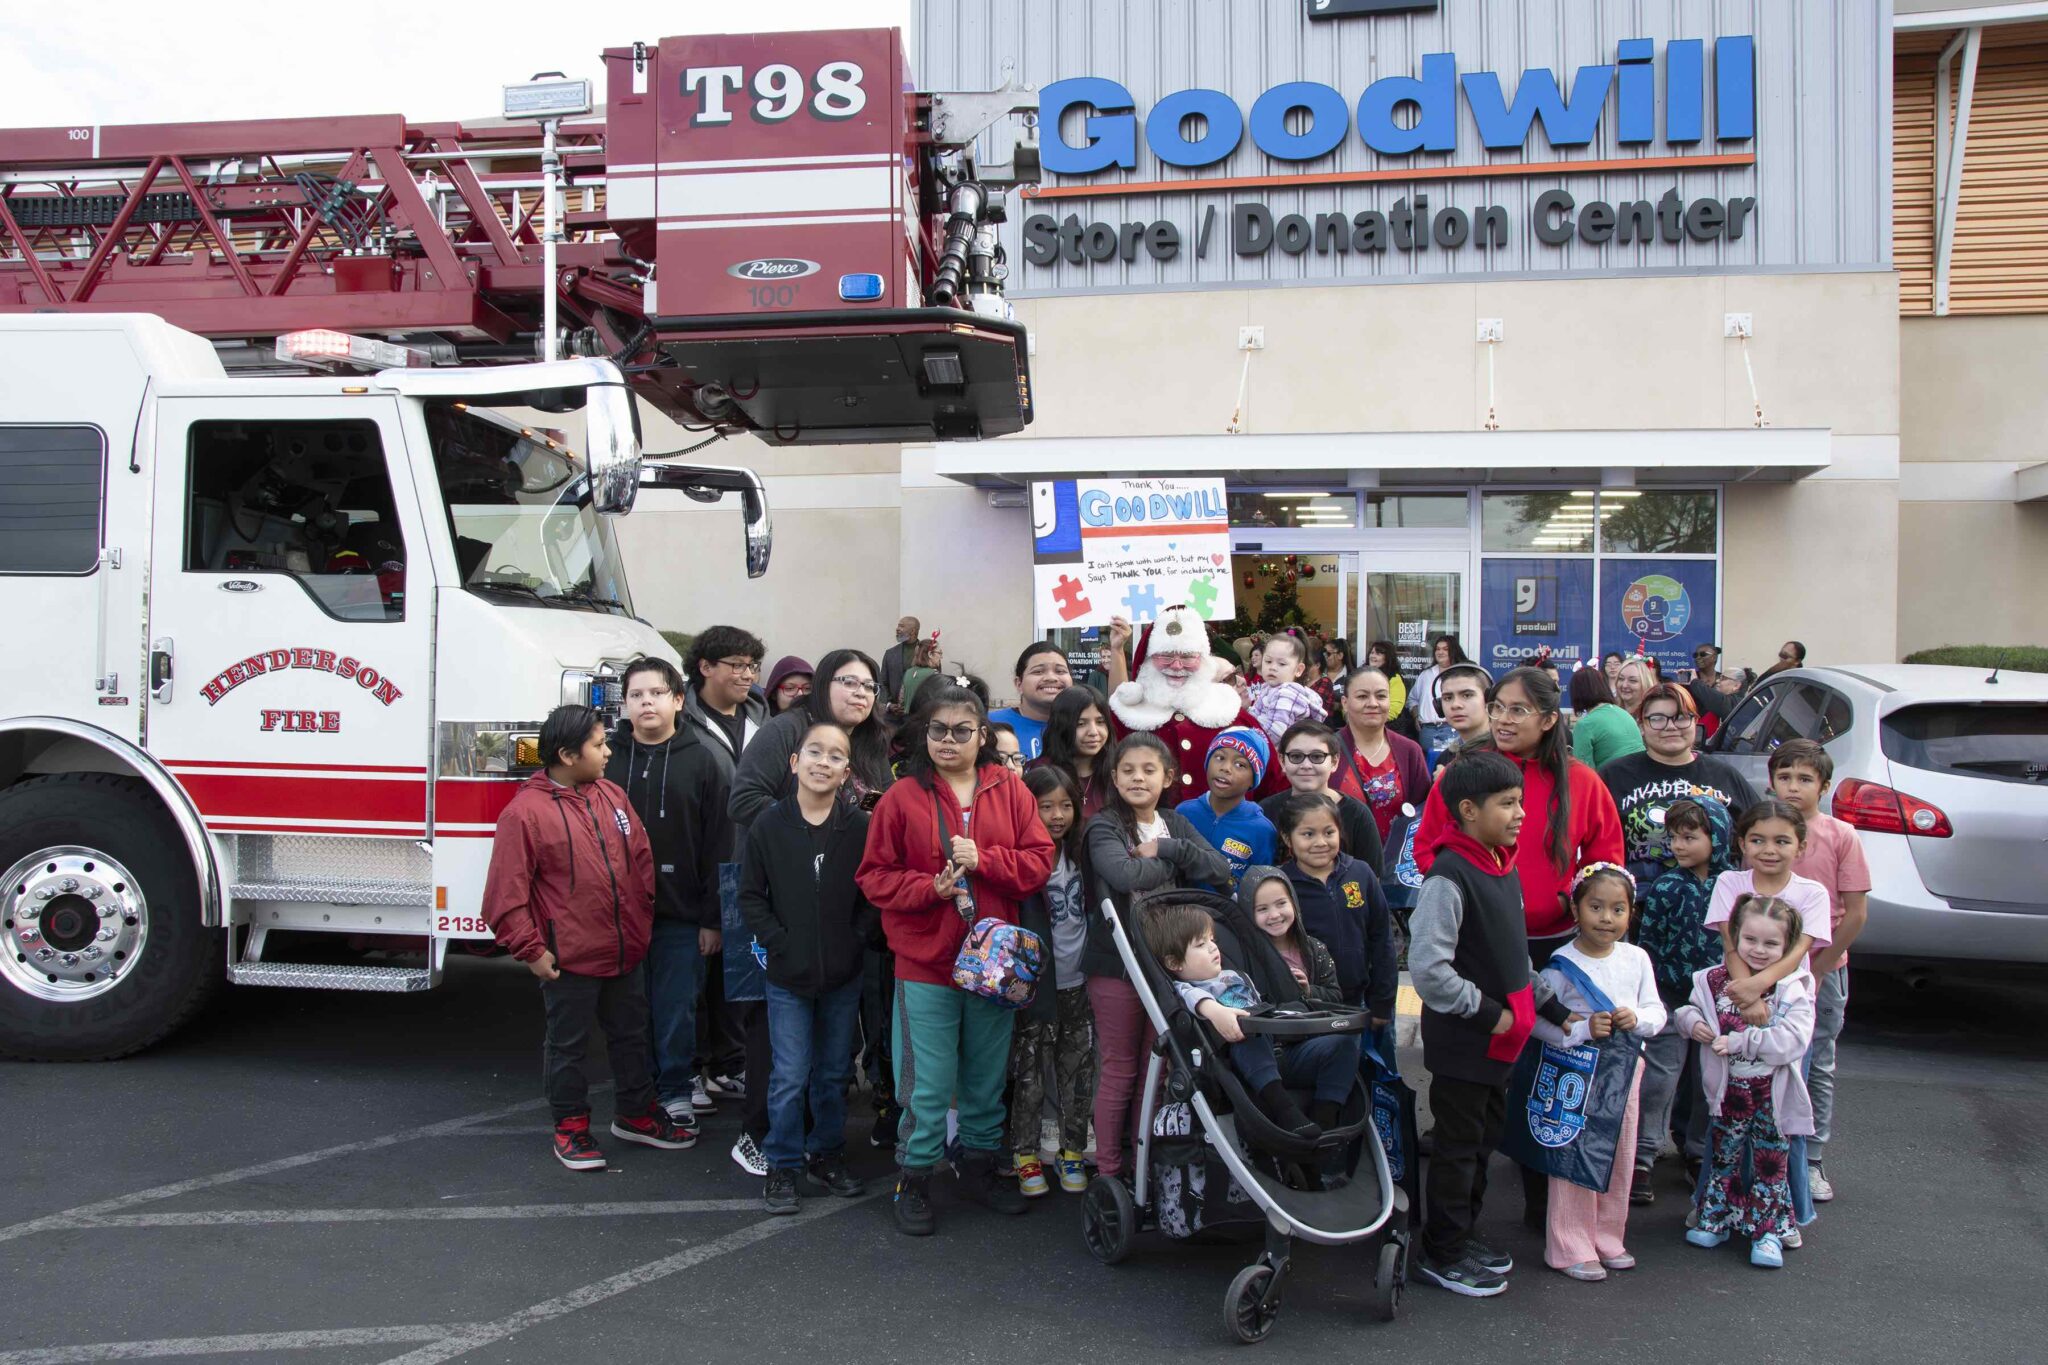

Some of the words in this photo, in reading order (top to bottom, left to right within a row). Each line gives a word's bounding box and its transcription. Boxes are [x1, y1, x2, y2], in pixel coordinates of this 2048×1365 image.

[680, 60, 868, 127] T98
[1039, 35, 1756, 175] Goodwill
[67, 129, 90, 141] 100
[1023, 211, 1180, 266] Store
[1234, 195, 1509, 257] Donation
[1535, 186, 1757, 247] Center
[746, 260, 799, 277] Pierce
[1121, 479, 1153, 491] Thank
[1080, 487, 1228, 527] GOODWILL
[1088, 560, 1095, 570] I
[1136, 557, 1152, 565] with
[1180, 554, 1194, 563] but
[1197, 555, 1210, 564] my
[1321, 563, 1339, 574] CH
[1087, 572, 1107, 584] Says
[1110, 568, 1141, 580] THANK
[1166, 566, 1178, 576] for
[1180, 565, 1216, 580] including
[1216, 567, 1231, 575] me
[1398, 622, 1421, 634] BEST
[1515, 622, 1557, 634] goodwill
[1068, 651, 1087, 659] RETAIL
[1666, 659, 1676, 667] for
[1492, 661, 1512, 669] SHOP
[199, 646, 403, 707] HENDERSON
[259, 709, 341, 733] FIRE
[1208, 734, 1264, 775] SONIC
[1621, 777, 1694, 811] INVADER
[438, 916, 488, 932] 2138
[1537, 1062, 1586, 1110] 50
[1564, 1113, 1581, 1124] 2025
